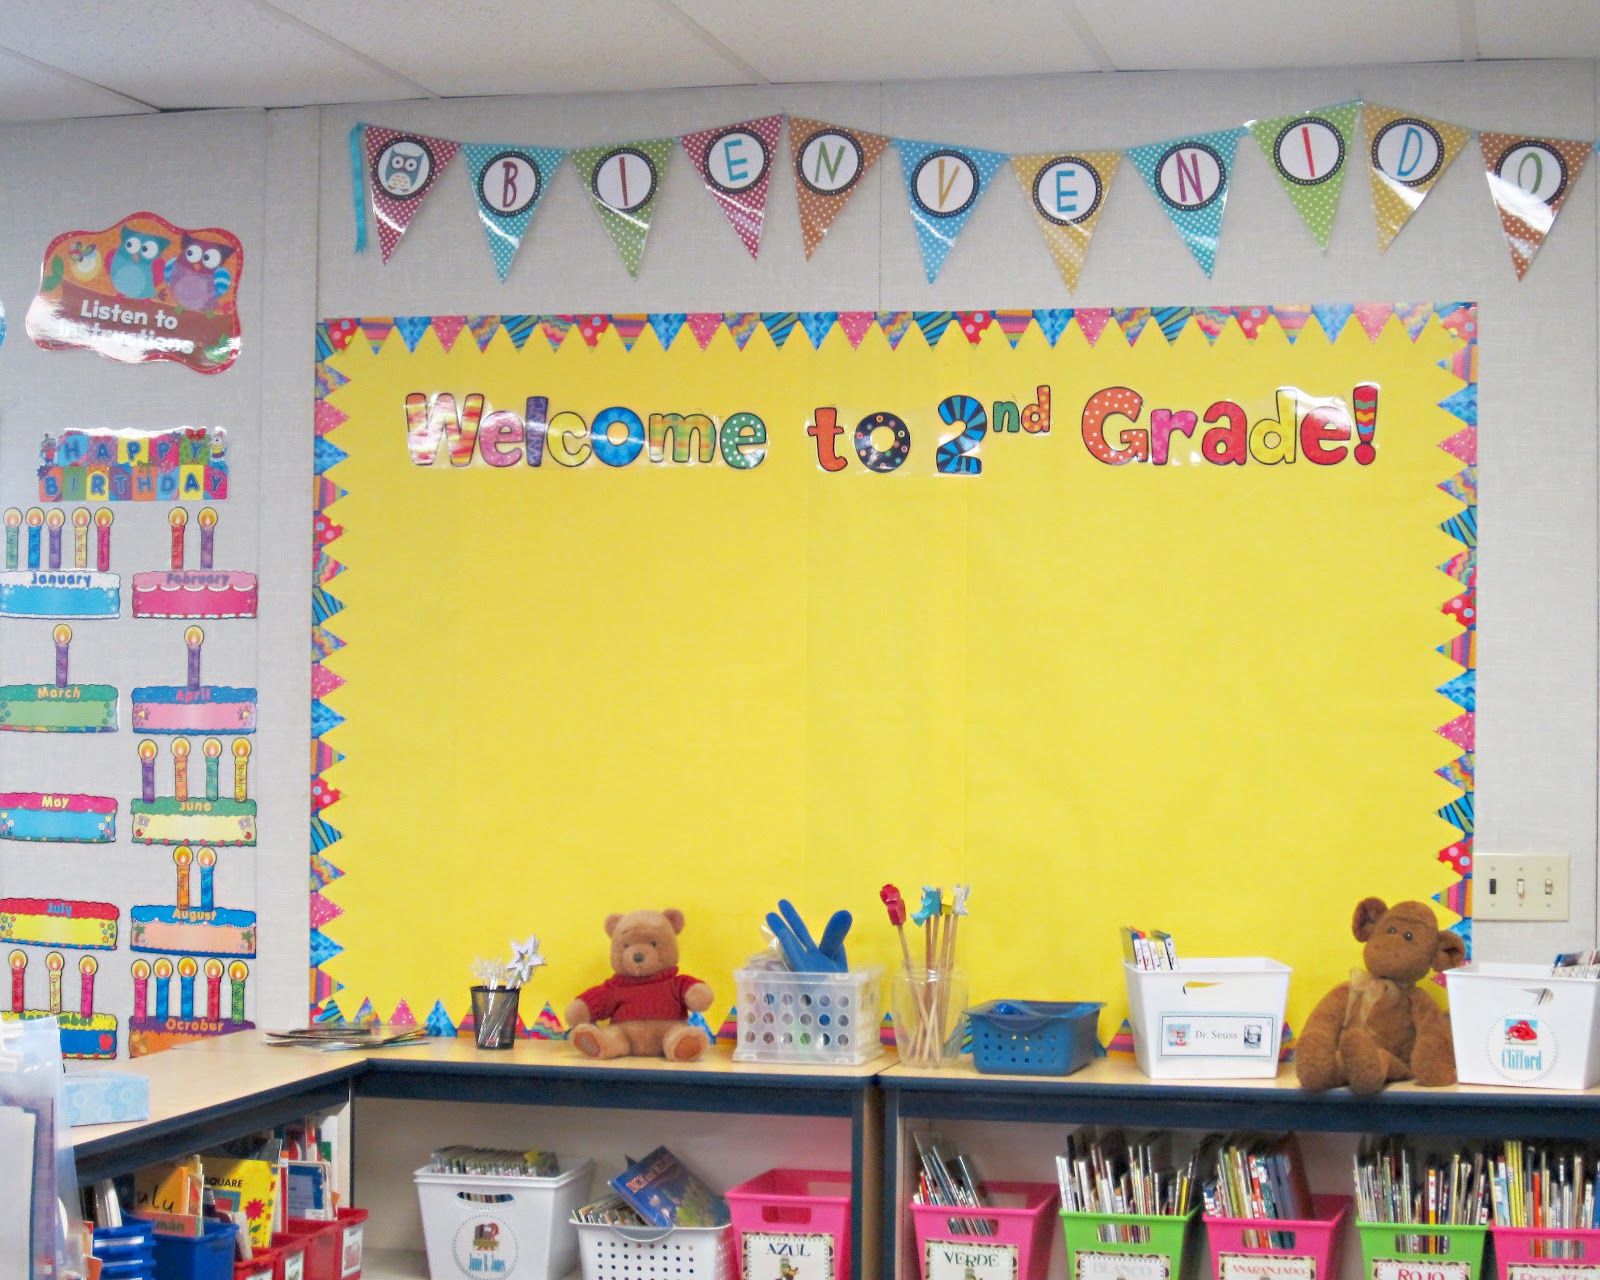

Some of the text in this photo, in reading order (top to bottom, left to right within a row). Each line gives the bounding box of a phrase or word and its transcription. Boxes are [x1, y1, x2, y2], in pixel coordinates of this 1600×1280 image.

[80, 299, 178, 330] Listen to
[404, 384, 1379, 475] Welcome to 2nd Grade!
[64, 440, 203, 461] HAPPY
[44, 474, 222, 497] BIRTHDAY
[30, 572, 92, 588] January
[166, 571, 230, 587] February
[37, 687, 81, 699] March
[175, 688, 211, 702] April
[41, 795, 70, 809] May
[179, 801, 212, 812] June
[47, 902, 72, 917] July
[172, 909, 217, 922] August
[1195, 1030, 1238, 1040] Dr. Seuss
[1501, 1049, 1542, 1071] Clifford
[204, 1177, 243, 1188] SQUARE
[766, 1242, 811, 1257] AZUL
[944, 1251, 1000, 1267] VERDE
[1397, 1268, 1445, 1280] ROJO
